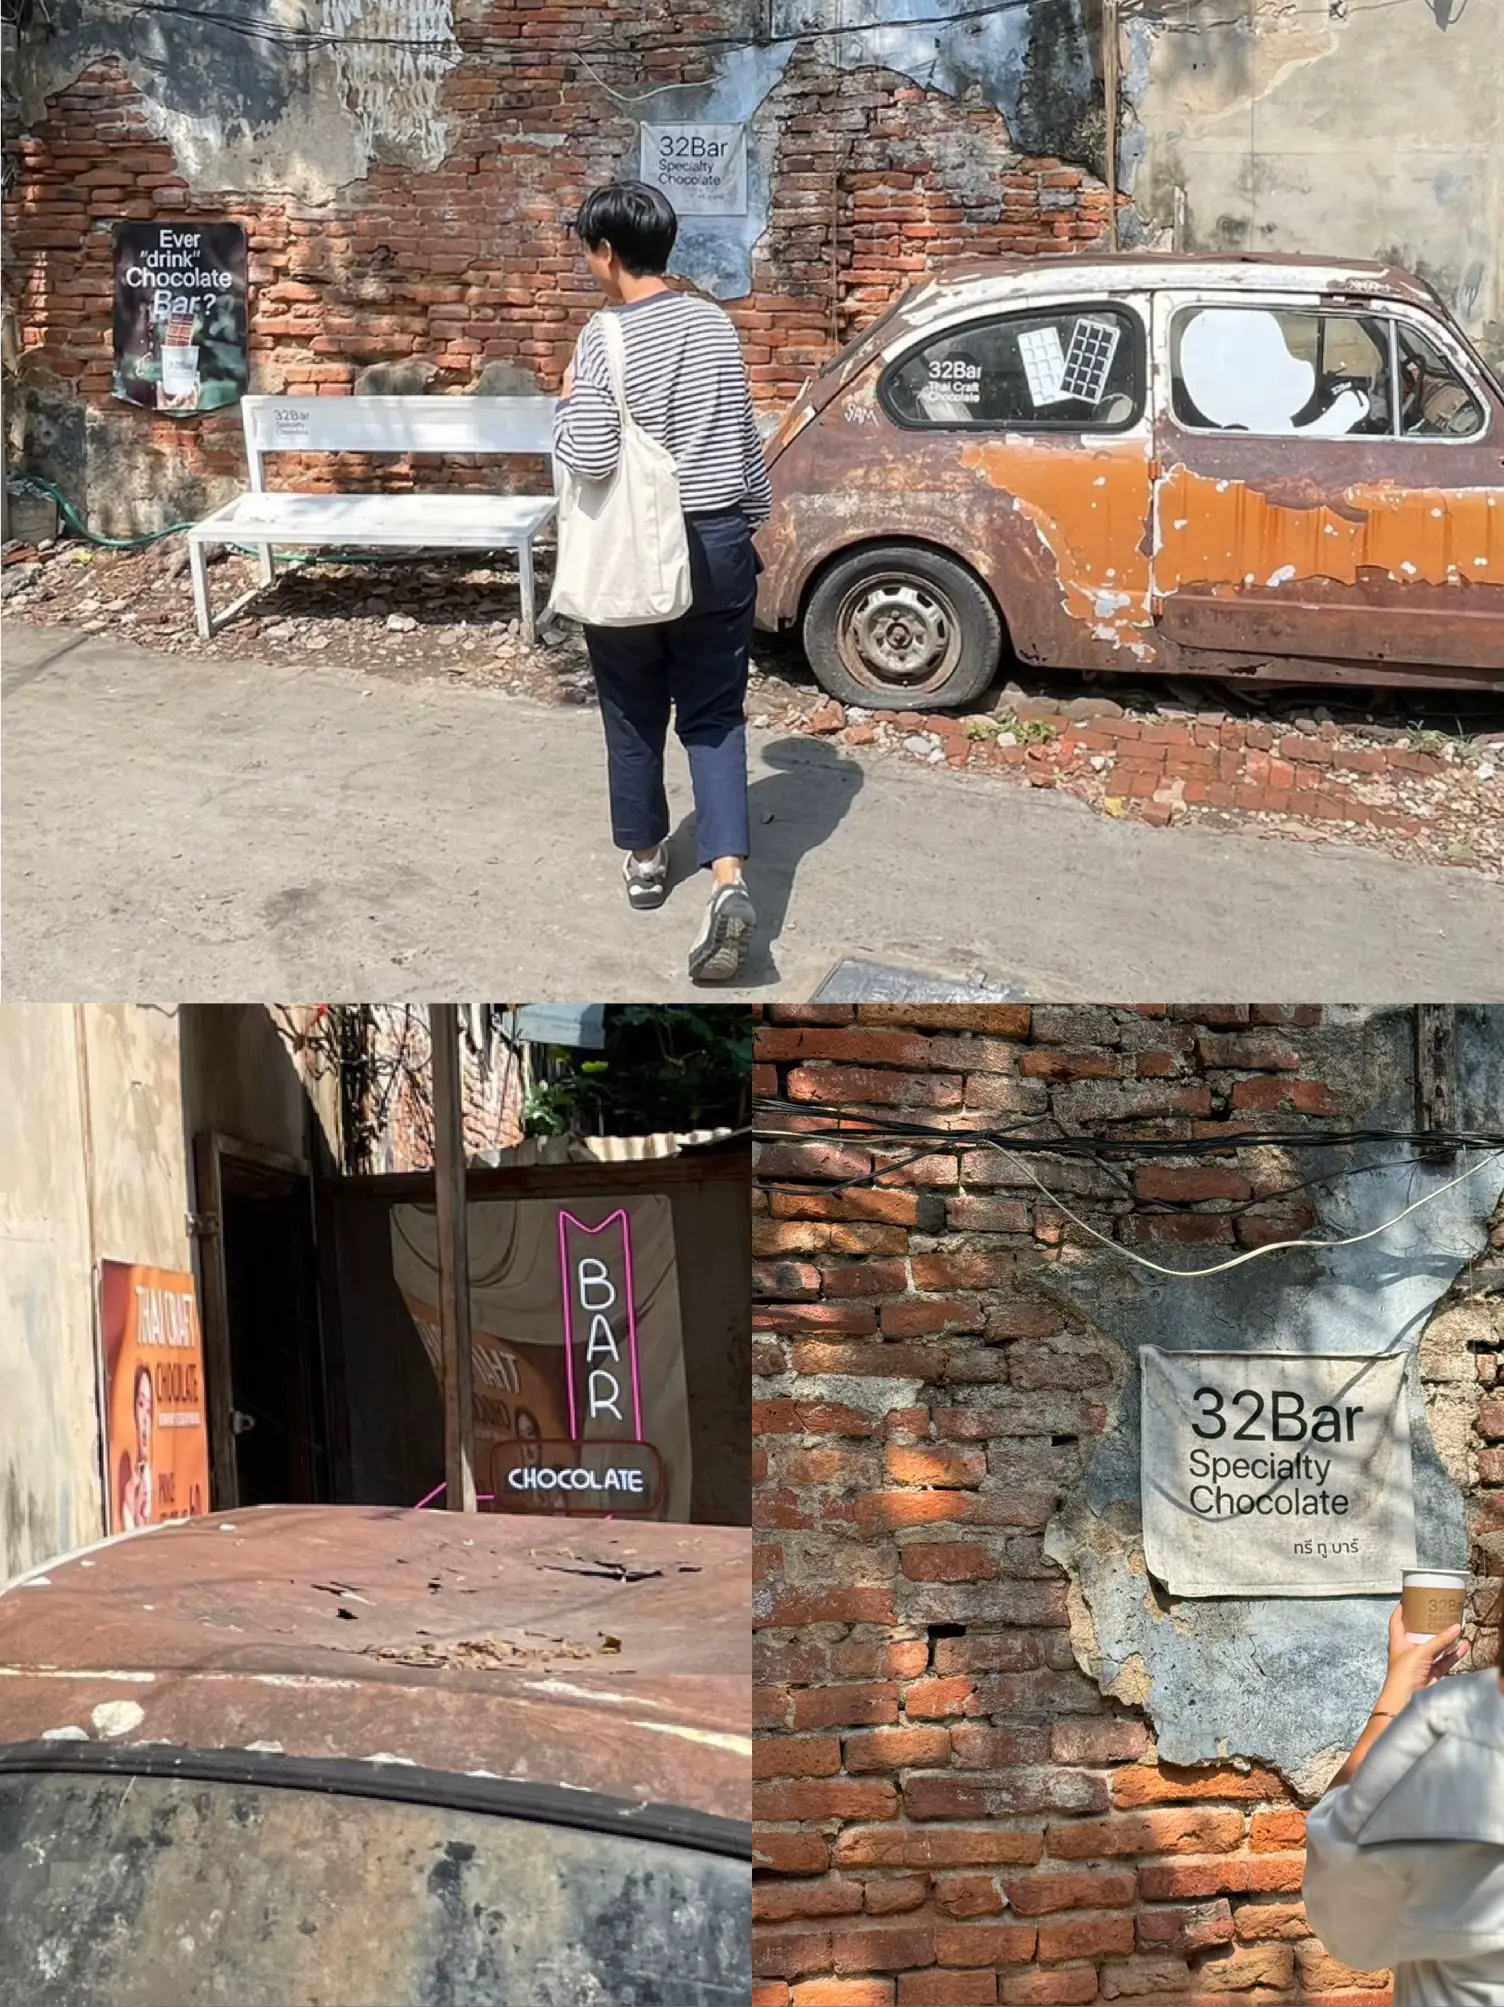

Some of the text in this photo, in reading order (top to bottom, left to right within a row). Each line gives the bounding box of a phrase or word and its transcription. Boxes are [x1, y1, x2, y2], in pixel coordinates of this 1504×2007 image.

[659, 136, 728, 157] 32Bar
[160, 229, 201, 248] Ever
[126, 266, 233, 288] Chocolate
[928, 360, 982, 380] 32Bar
[274, 409, 310, 421] 32Bar
[578, 1258, 623, 1420] BAR
[1192, 1386, 1364, 1443] 32Bar
[1189, 1448, 1331, 1486] Specialty
[508, 1467, 644, 1492] CHOCOLATE
[1189, 1485, 1349, 1516] Chocolate
